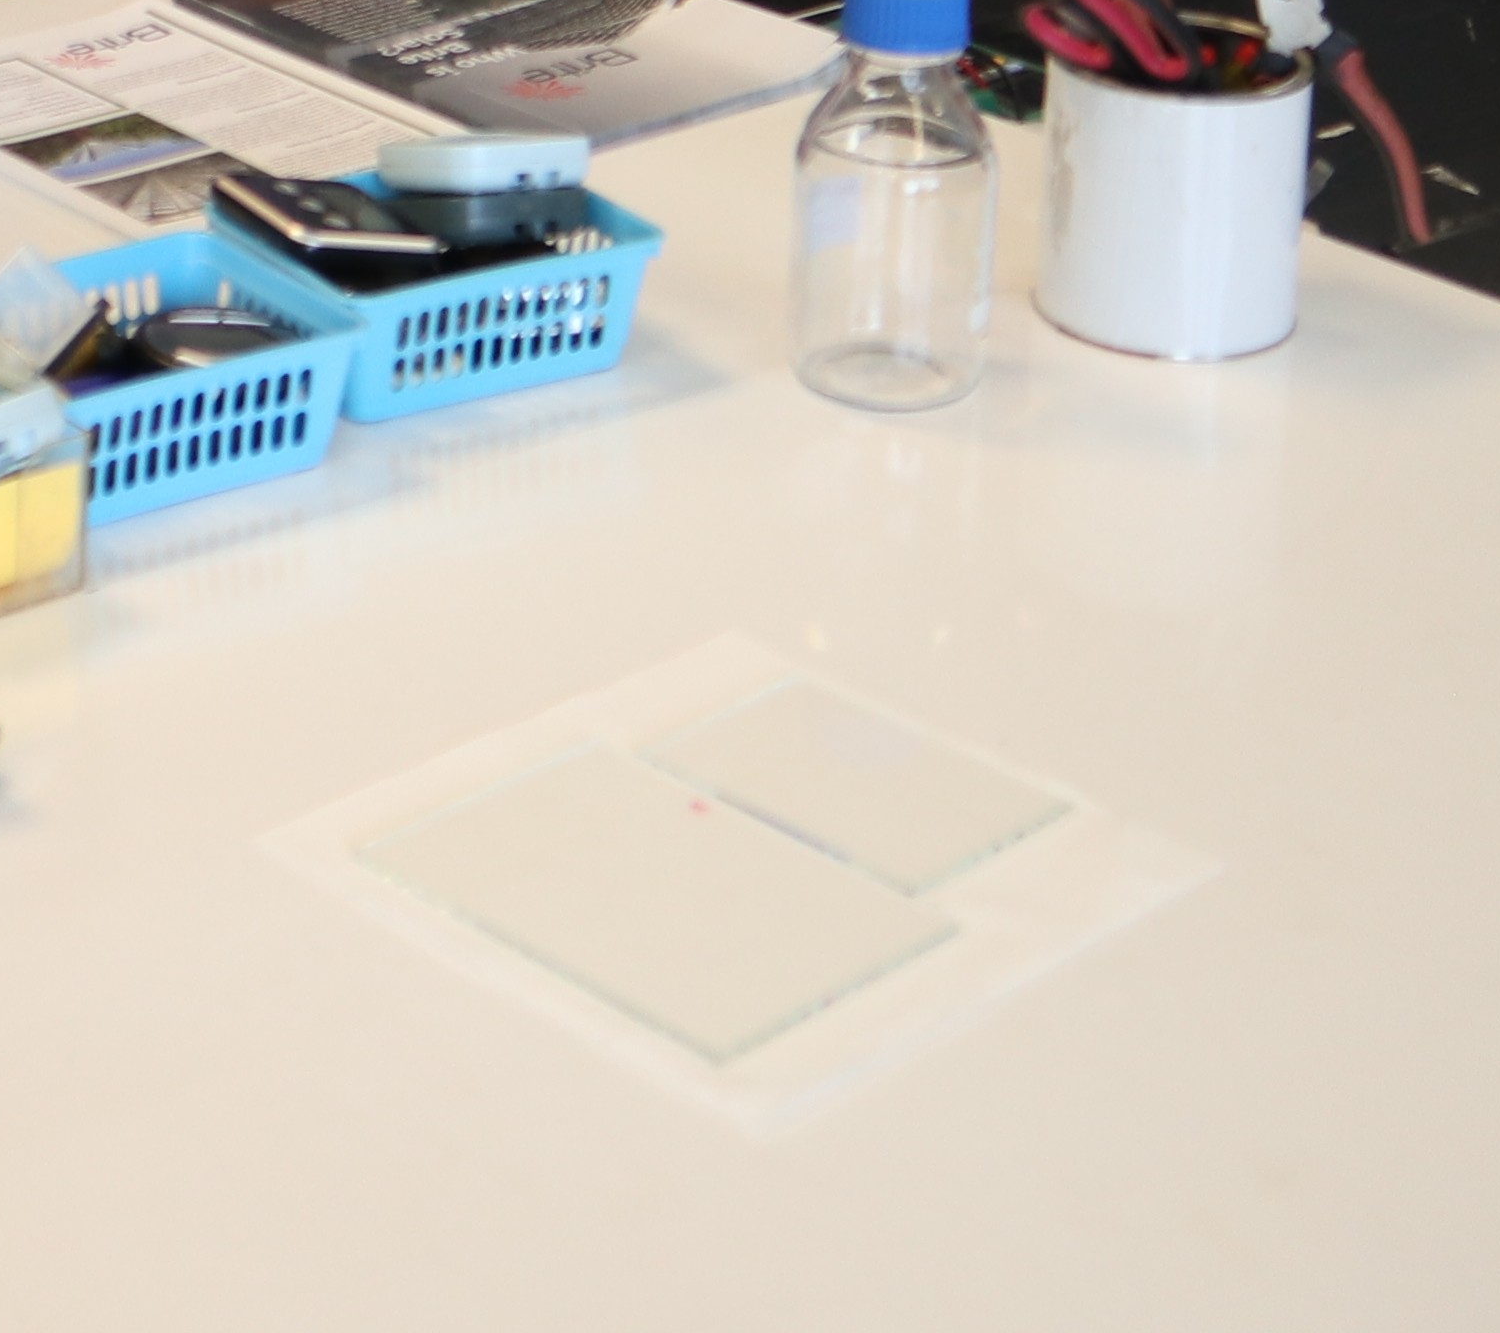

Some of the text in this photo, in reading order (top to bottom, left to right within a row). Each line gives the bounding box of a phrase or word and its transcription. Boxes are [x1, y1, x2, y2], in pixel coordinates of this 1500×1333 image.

[64, 22, 171, 59] Brite
[377, 25, 466, 57] Solar?
[396, 39, 471, 67] Brite
[424, 57, 456, 80] is
[521, 47, 639, 88] Brite
